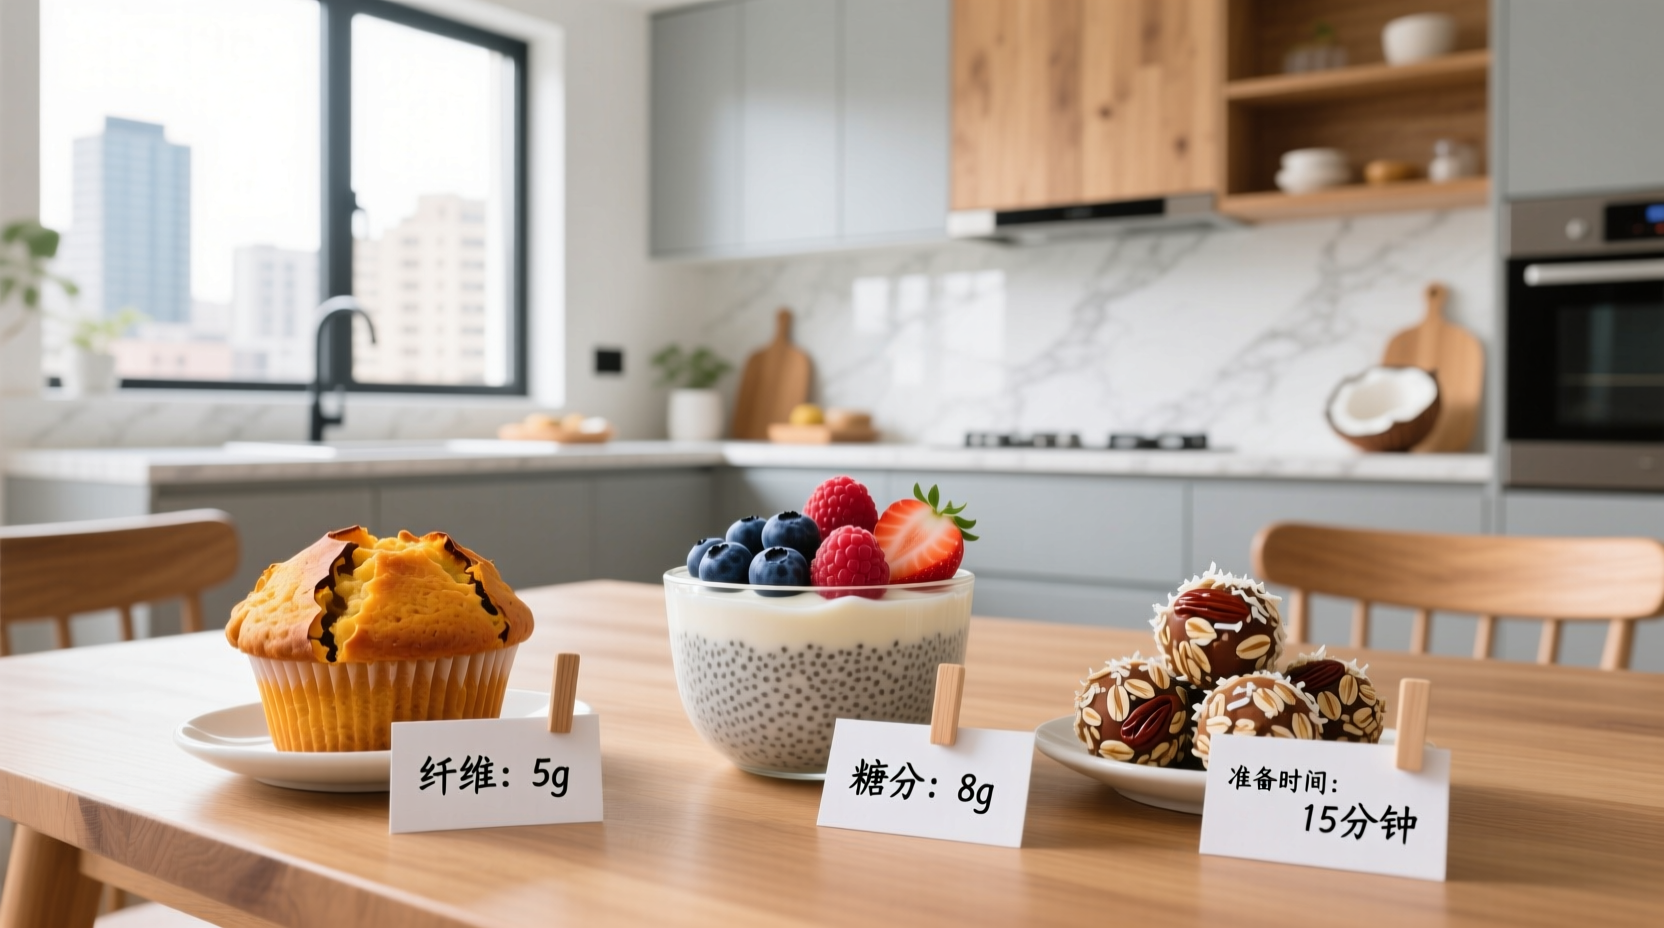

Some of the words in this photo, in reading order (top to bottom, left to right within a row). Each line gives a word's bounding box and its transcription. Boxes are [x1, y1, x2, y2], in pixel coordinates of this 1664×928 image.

[1229, 765, 1337, 795] 准备时间：
[1305, 803, 1417, 844] 15分钟
